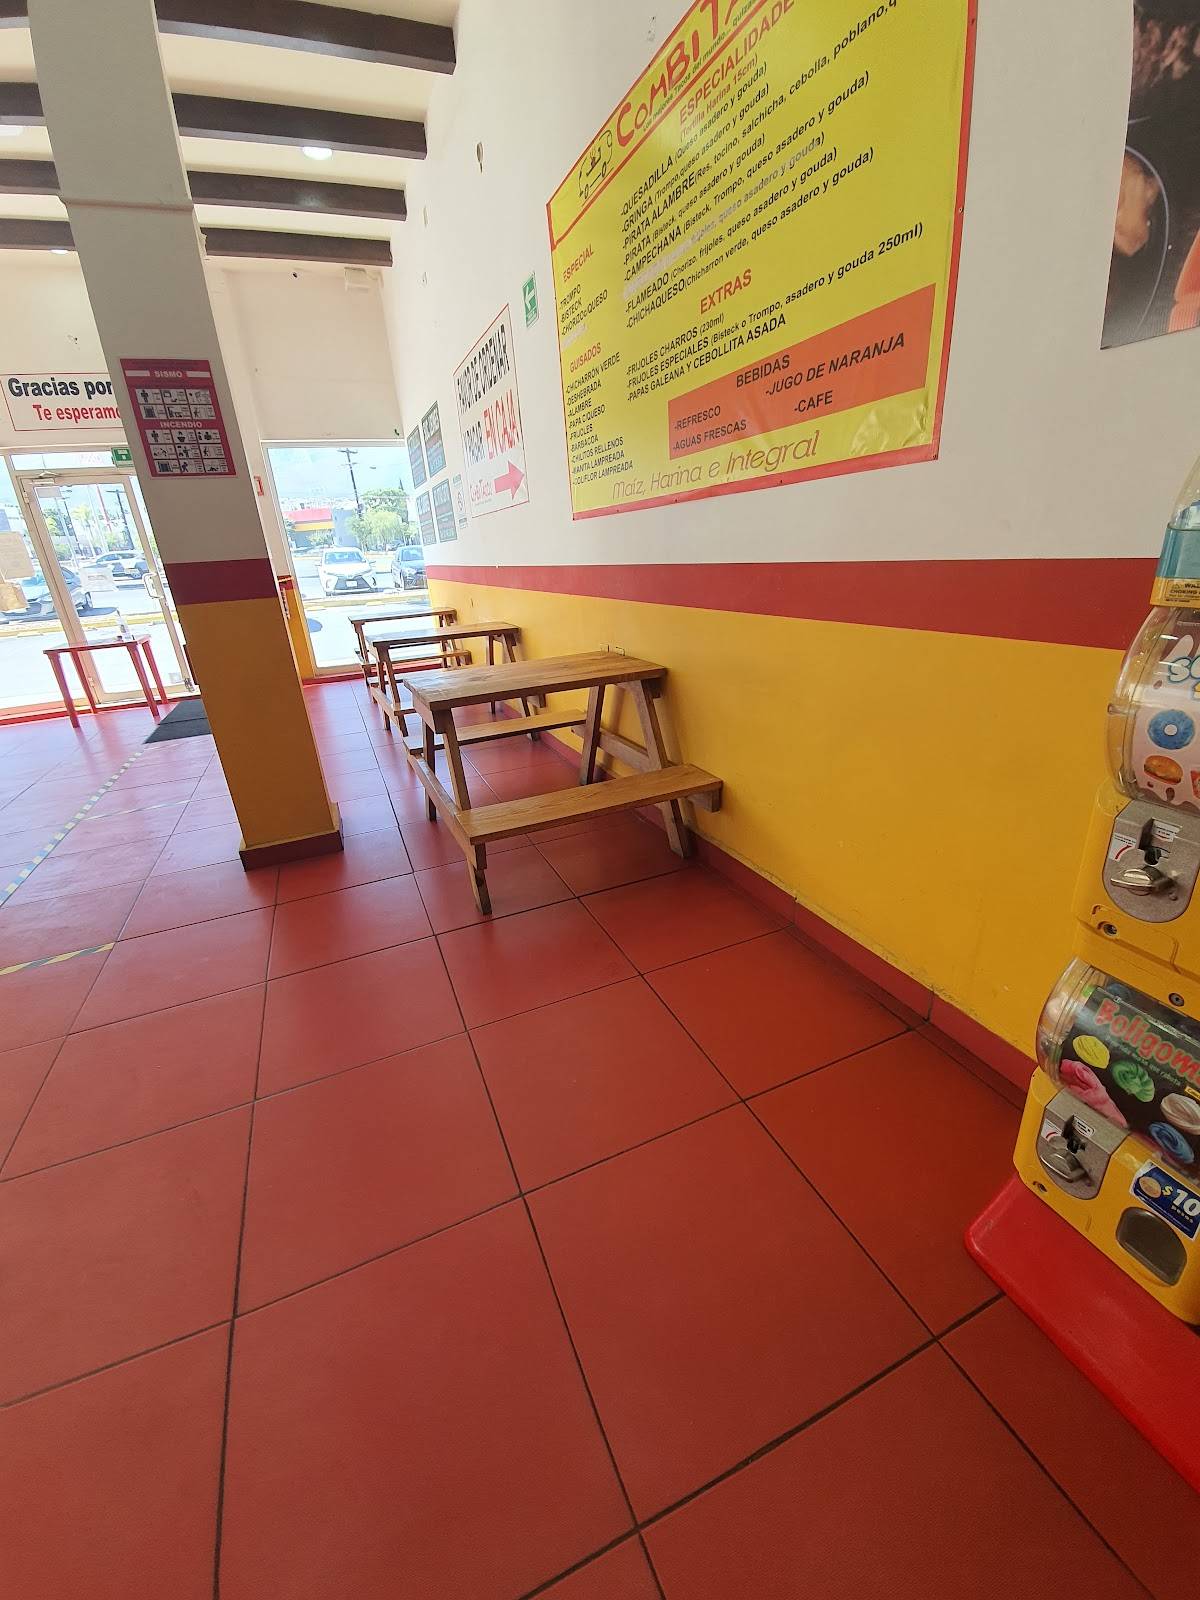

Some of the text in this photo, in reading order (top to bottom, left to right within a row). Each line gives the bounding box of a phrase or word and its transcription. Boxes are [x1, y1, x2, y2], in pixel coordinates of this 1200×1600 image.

[733, 54, 758, 85] 15cm)
[621, 155, 673, 215] -QUESADILLA
[700, 102, 728, 137] asadero
[730, 97, 736, 109] y
[737, 62, 767, 101] gouda)
[622, 196, 653, 232] -GRINGA
[701, 122, 730, 155] asadero
[732, 117, 737, 128] y
[739, 83, 769, 121] gouda)
[623, 219, 651, 250] -PIRATA
[714, 137, 740, 164] tocino,
[742, 94, 787, 138] salchicha,
[789, 56, 830, 95] cebolla,
[780, 165, 787, 177] y
[789, 131, 825, 170] gouda)
[623, 235, 651, 265] -PIRATA
[678, 195, 697, 217] queso
[699, 168, 728, 199] asadero
[729, 163, 735, 174] y
[736, 133, 766, 168] gouda)
[624, 225, 682, 281] -CAMPECHANA
[683, 204, 711, 234] (Bisteck,
[713, 177, 745, 206] Trompo,
[746, 151, 773, 178] queso
[775, 116, 815, 154] asadero
[818, 108, 825, 123] y
[828, 70, 870, 115] gouda)
[725, 237, 748, 259] verde,
[751, 216, 778, 241] queso
[780, 186, 820, 220] asadero
[822, 179, 830, 193] y
[832, 146, 874, 186] gouda)
[625, 272, 669, 313] -FLAMEADO
[727, 212, 751, 237] queso
[753, 185, 789, 217] asadero
[791, 177, 798, 191] y
[800, 146, 837, 184] gouda)
[563, 244, 594, 282] ESPECIAL
[700, 268, 752, 315] EXTRAS
[626, 221, 923, 389] -FRIJOLES ESPECIALES (Bisteck o Trompo, asadero y gouda 250ml)
[479, 323, 510, 396] ORDENAR
[569, 342, 601, 373] GUISADOS
[600, 351, 620, 372] VERDE
[626, 312, 725, 376] -FRIJOLES CHARROS (230ml)
[627, 312, 787, 402] -PAPAS GALEANA Y CEBOLLITA ASADA
[736, 354, 790, 388] BEBIDAS
[765, 332, 905, 396] -JUGO DE NARANJA
[8, 377, 113, 400] Gracias por
[32, 404, 52, 420] Te
[674, 405, 721, 430] -REFRESCO
[793, 390, 833, 413] -CAFE
[484, 405, 498, 460] EN
[496, 388, 519, 455] CAJA
[594, 436, 624, 455] RELLENOS
[672, 419, 747, 452] -AGUAS FRESCAS
[651, 462, 702, 491] Harina
[708, 460, 720, 477] e
[726, 430, 820, 475] Integral
